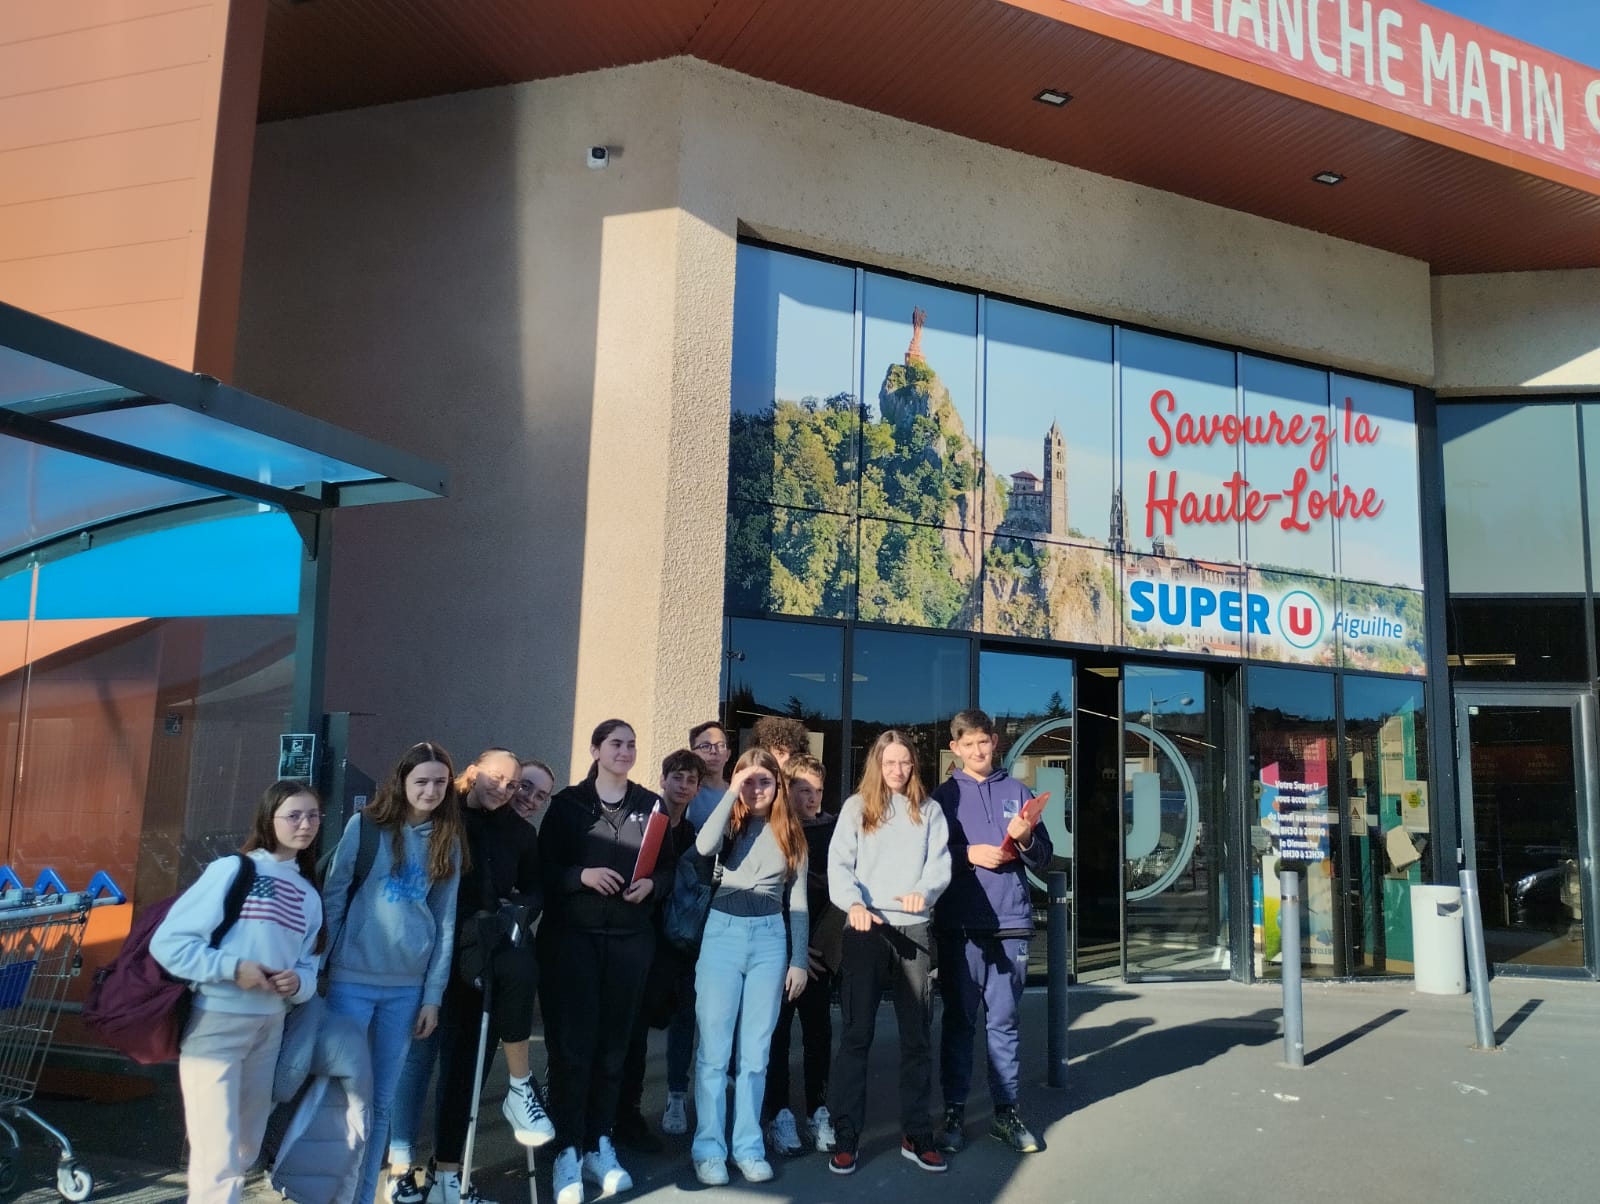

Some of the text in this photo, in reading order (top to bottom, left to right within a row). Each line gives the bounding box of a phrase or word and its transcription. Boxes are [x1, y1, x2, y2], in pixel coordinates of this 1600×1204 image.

[1420, 23, 1565, 151] MATIN
[1148, 389, 1380, 471] Savourez la
[1145, 467, 1384, 537] Haute-Loire
[1129, 580, 1271, 635] SUPER
[1331, 611, 1403, 639] Aiguilhe
[1293, 781, 1312, 792] Super
